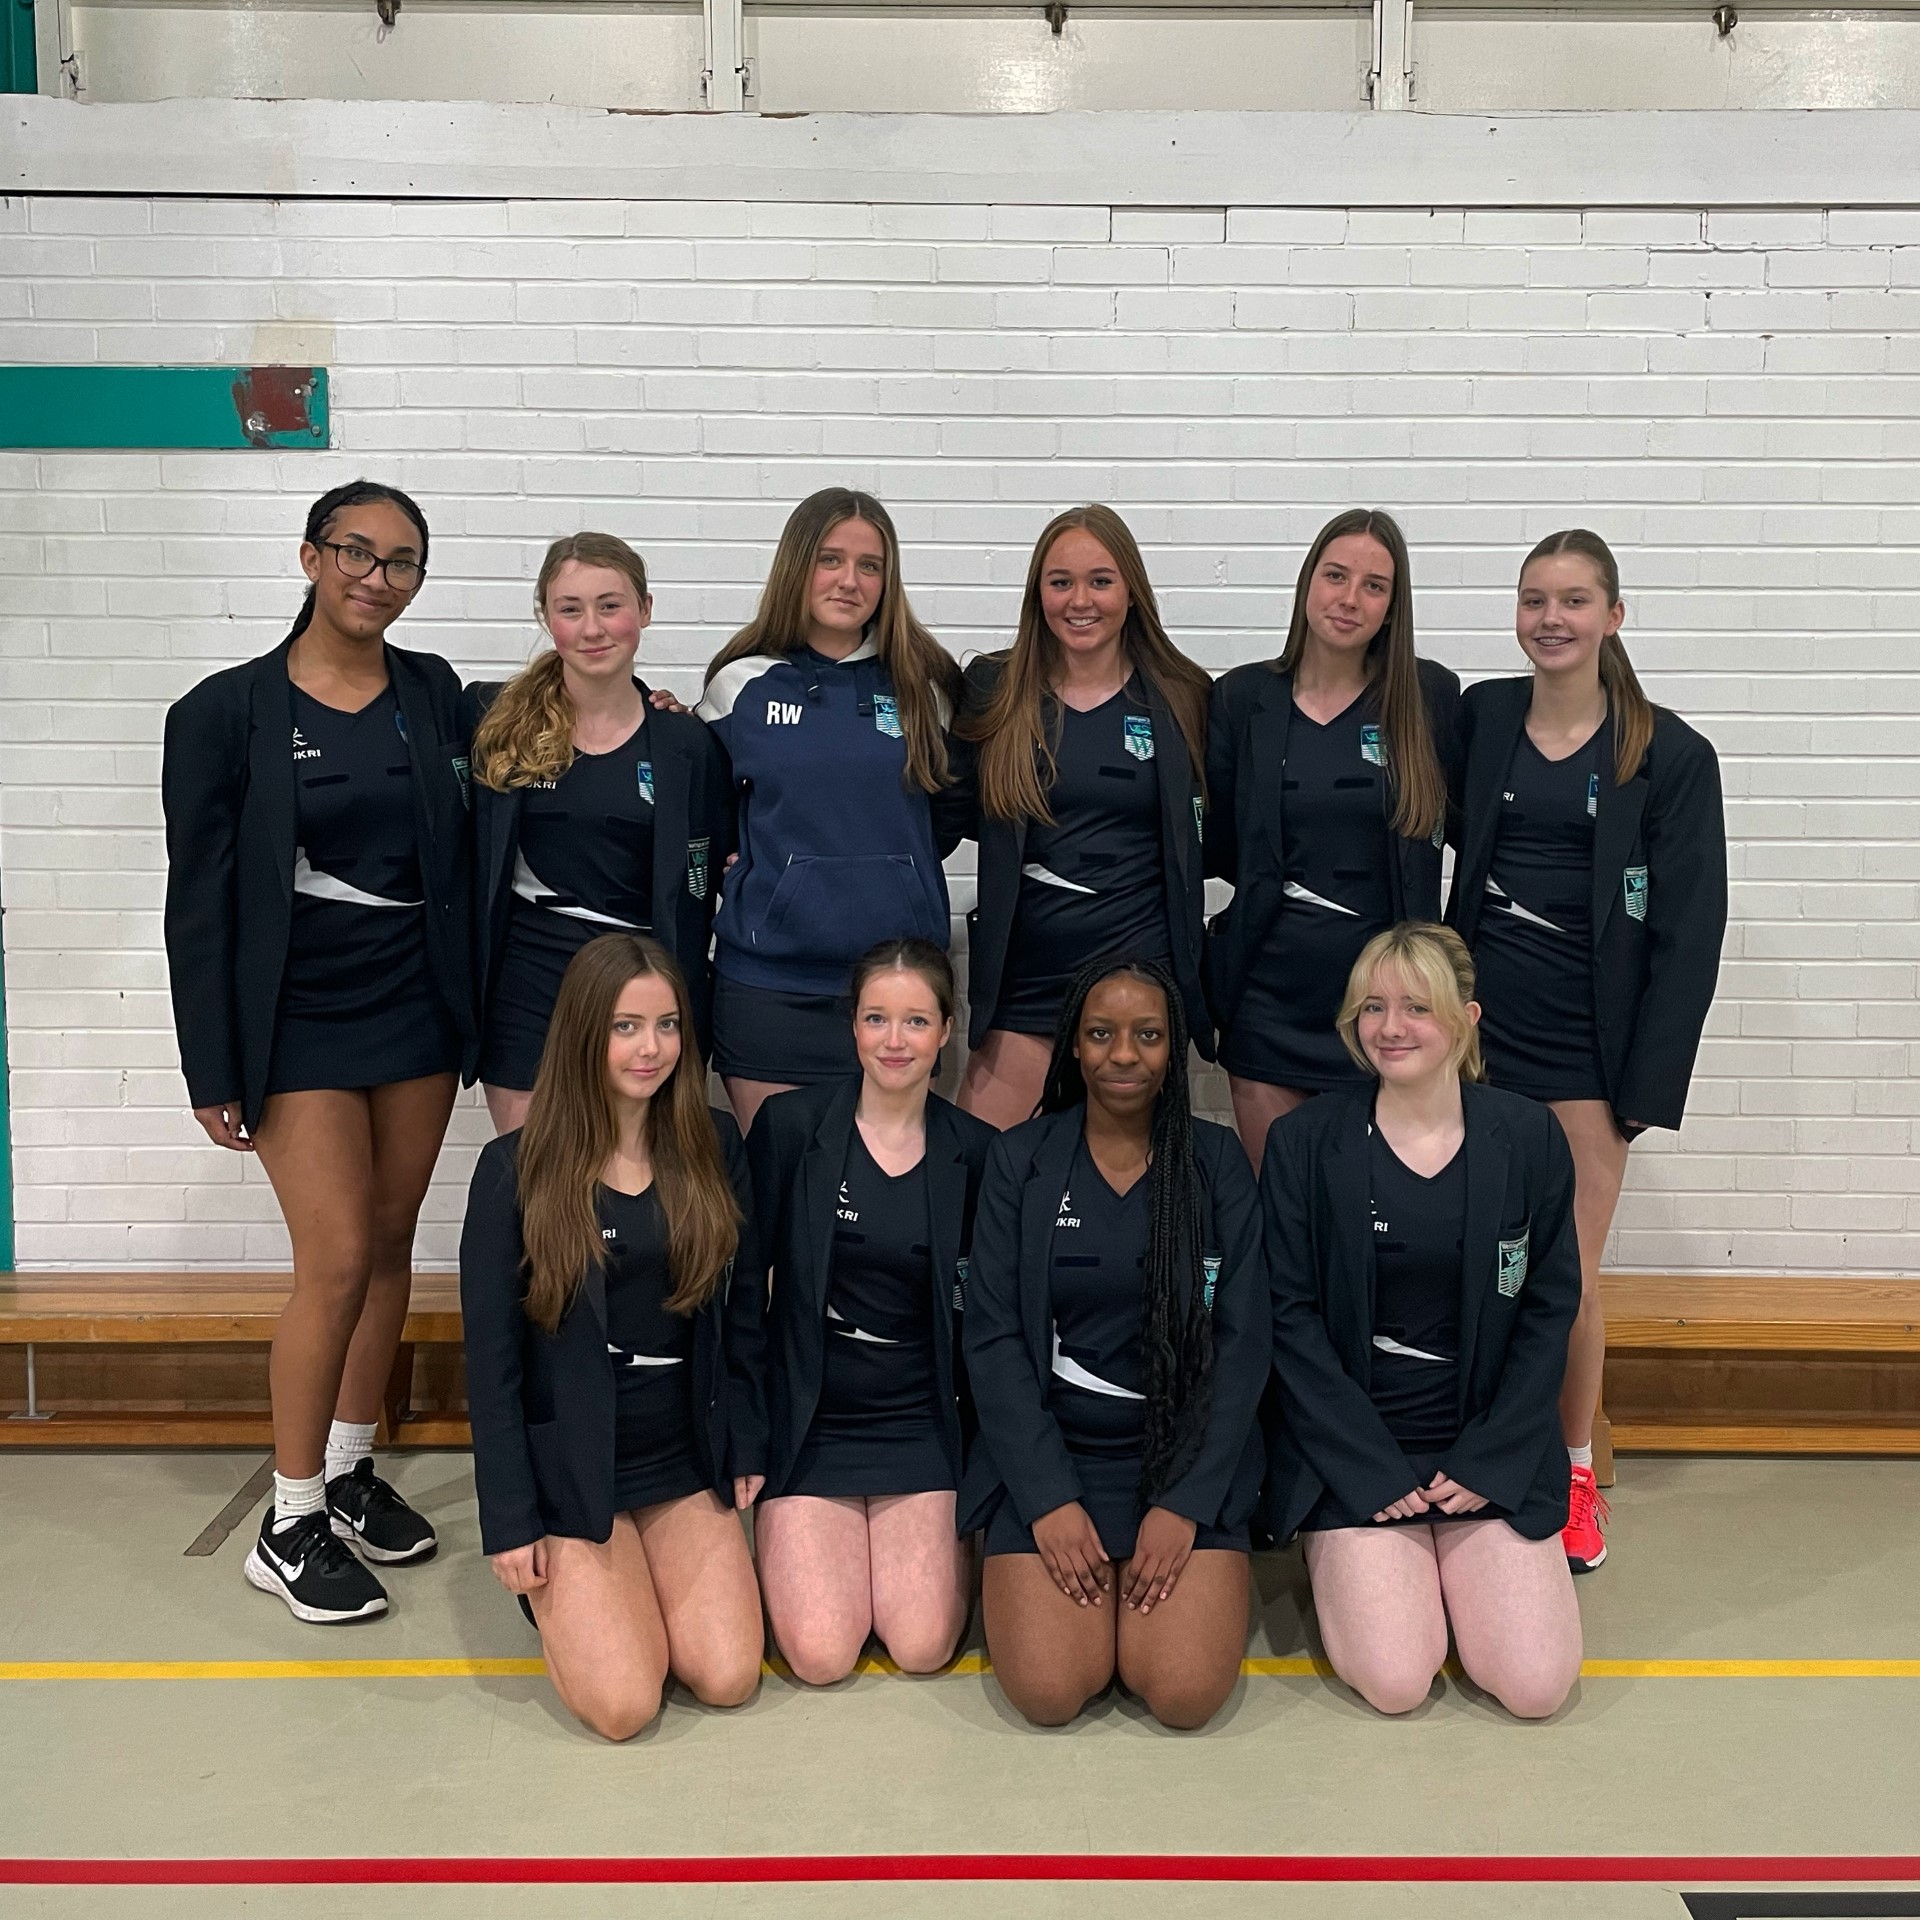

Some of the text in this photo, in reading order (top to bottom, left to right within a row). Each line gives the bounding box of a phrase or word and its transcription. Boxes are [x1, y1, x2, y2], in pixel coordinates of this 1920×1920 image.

[766, 700, 802, 725] RW
[293, 749, 322, 760] KRI
[836, 1208, 859, 1222] KRI
[1055, 1217, 1081, 1228] KRI
